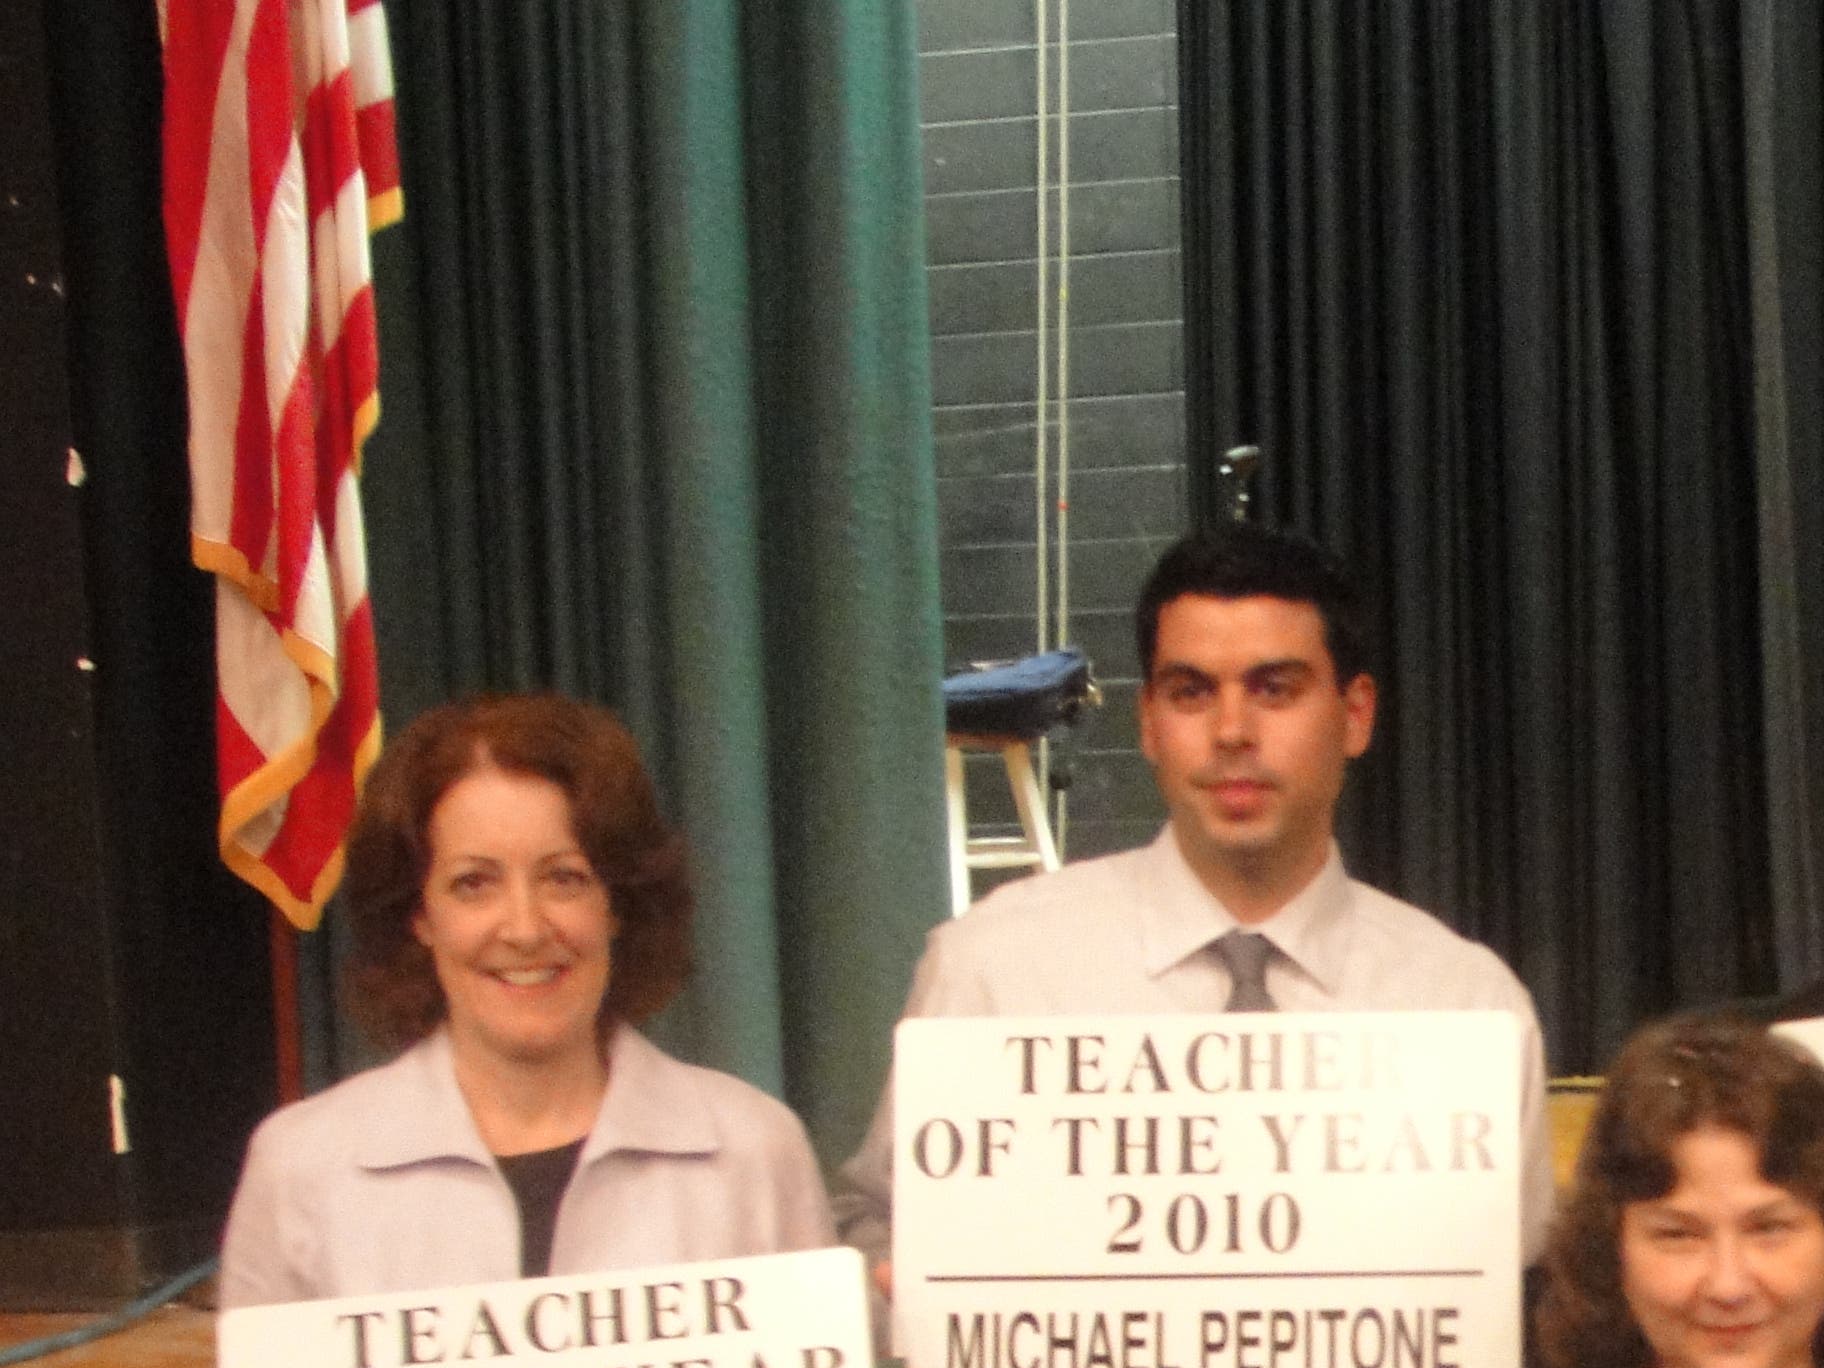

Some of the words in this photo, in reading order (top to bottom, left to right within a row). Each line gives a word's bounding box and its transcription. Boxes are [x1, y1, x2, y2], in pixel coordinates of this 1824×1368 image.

[912, 1117, 1017, 1179] OF
[1051, 1114, 1223, 1176] THE
[1259, 1109, 1498, 1174] YEAR
[1106, 1192, 1302, 1255] 2010
